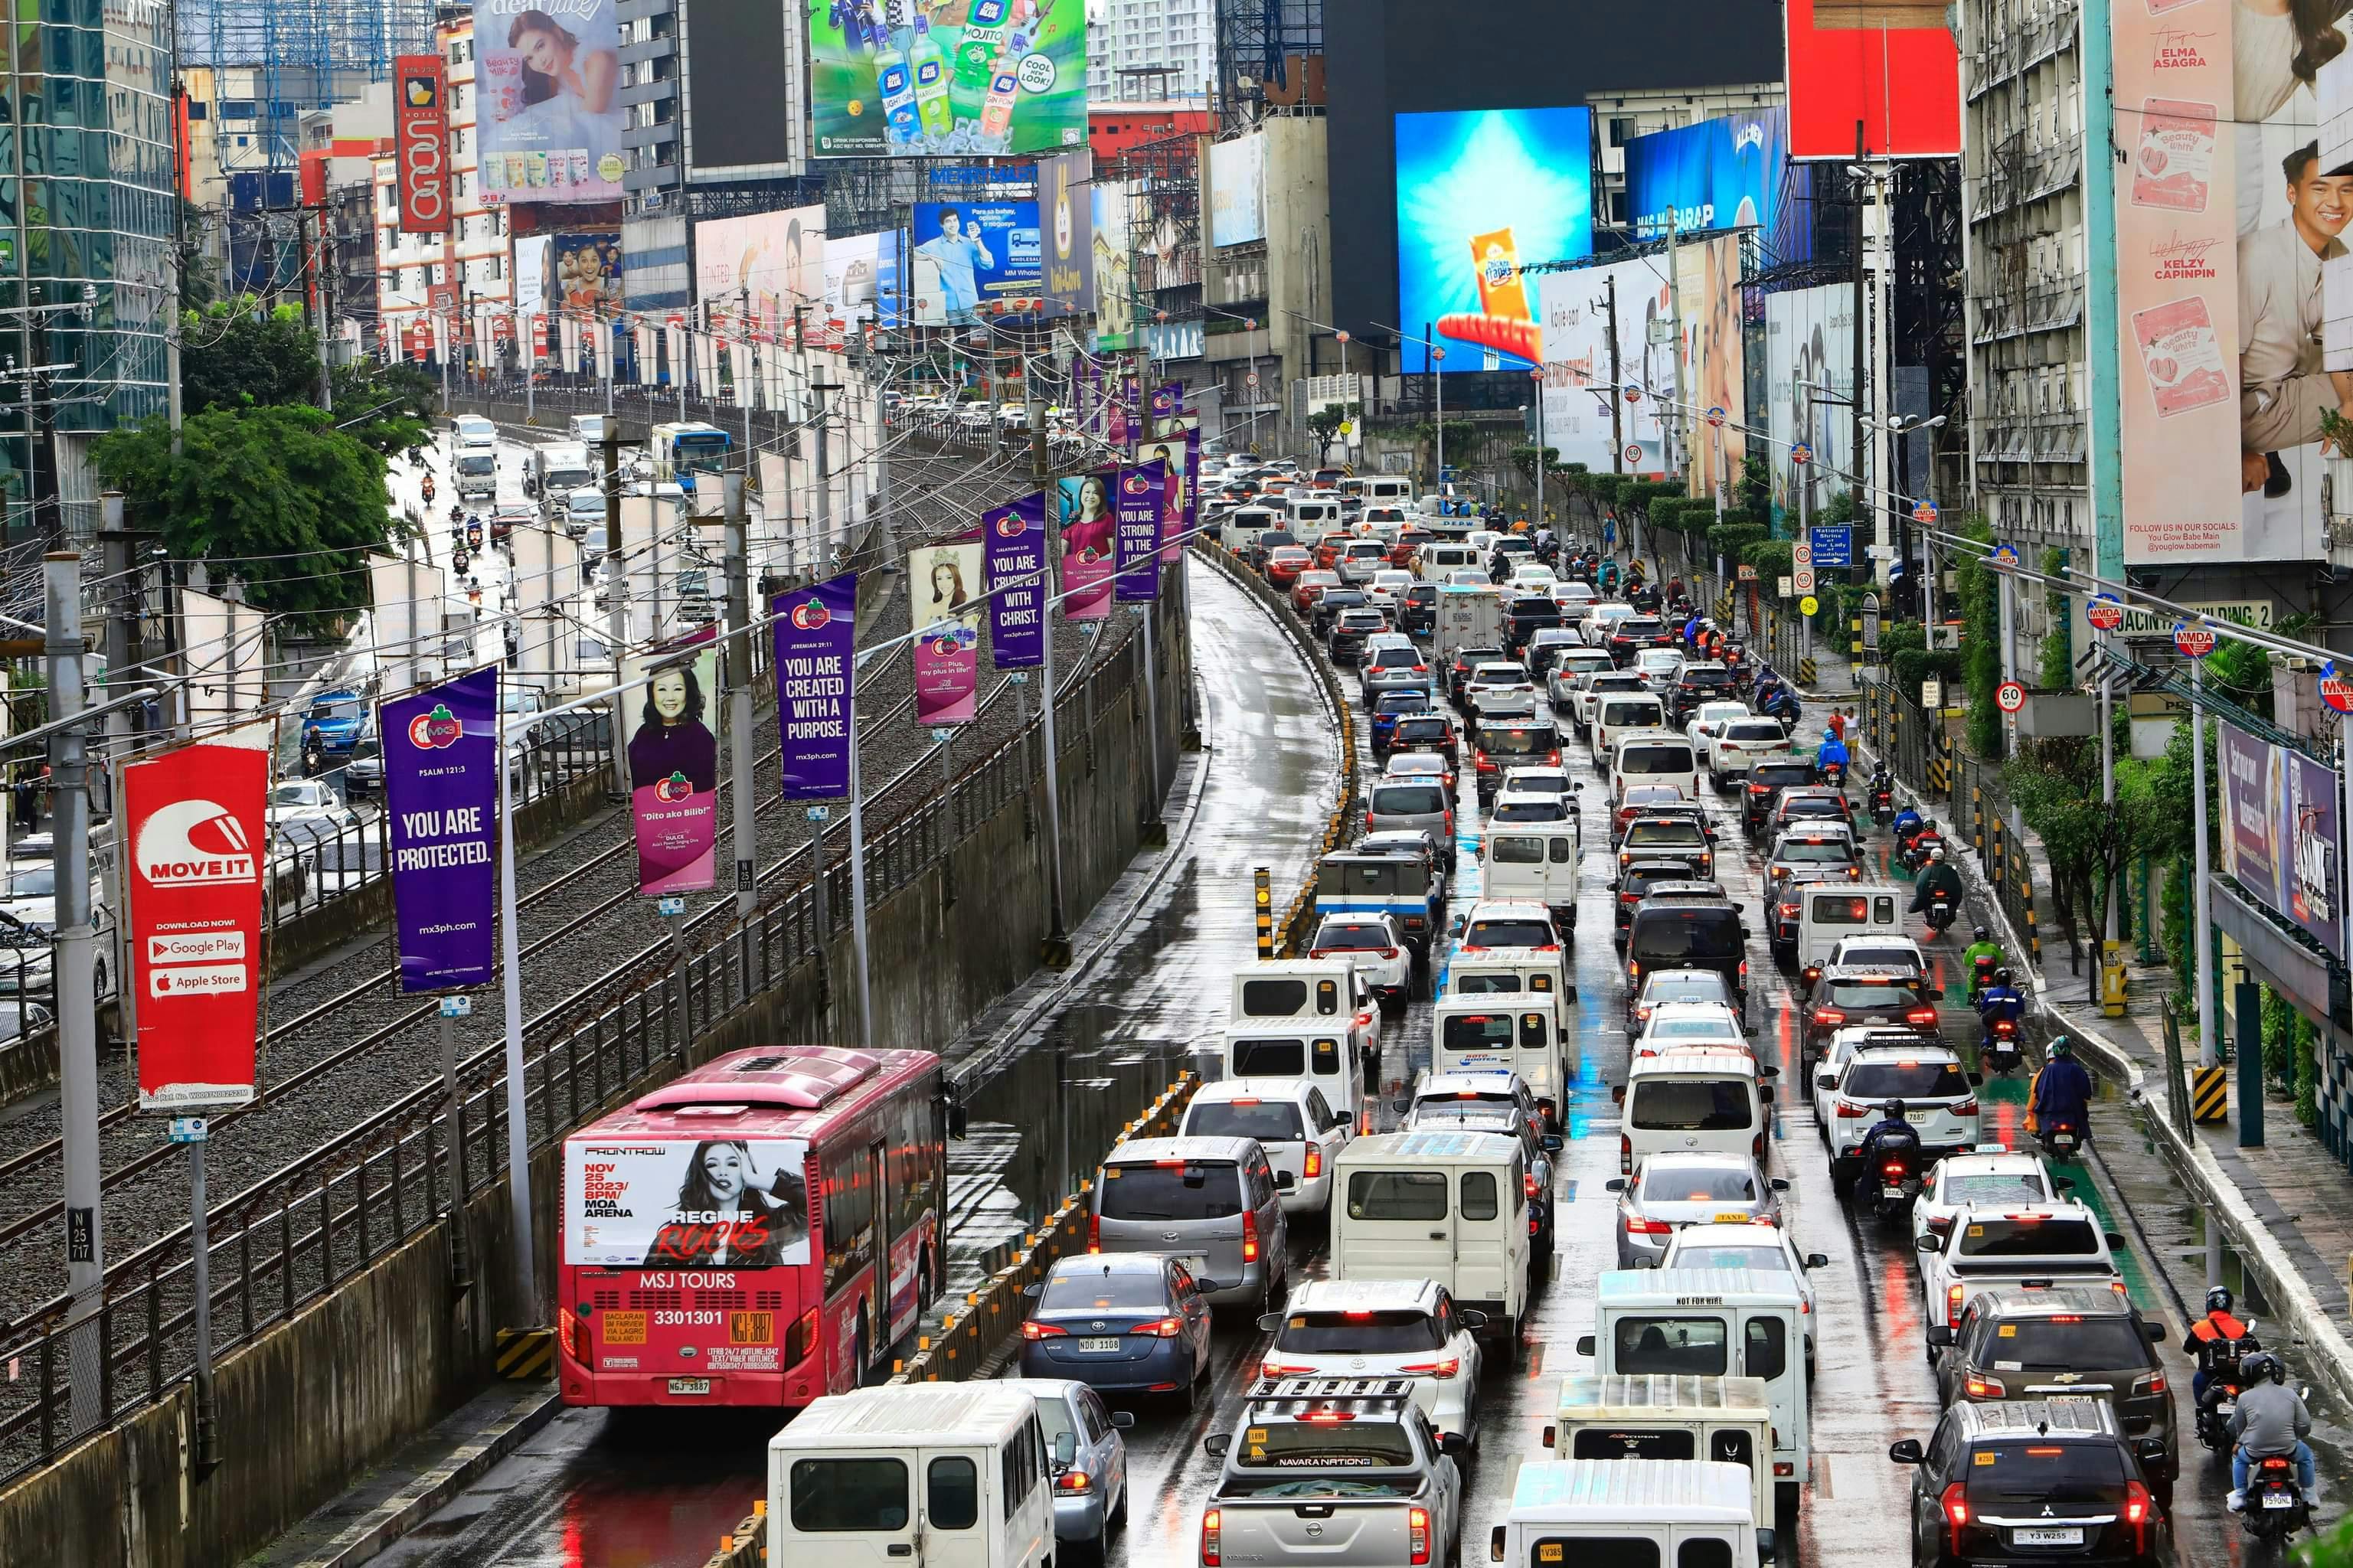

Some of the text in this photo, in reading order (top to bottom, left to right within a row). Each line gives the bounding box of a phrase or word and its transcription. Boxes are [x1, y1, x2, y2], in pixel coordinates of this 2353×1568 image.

[963, 28, 1003, 41] MOJITO
[2162, 48, 2197, 58] ELMA
[1026, 60, 1051, 72] COOL
[2153, 57, 2207, 69] ASAGRA
[1021, 74, 1050, 86] LOOK!
[2162, 132, 2201, 145] Beauty
[2170, 142, 2194, 152] White
[407, 119, 442, 220] SOGO
[1637, 216, 1655, 239] MAS
[2164, 259, 2205, 269] KELZY
[705, 263, 730, 284] TINTED
[2154, 269, 2215, 279] CAPINPIN
[2162, 330, 2198, 351] Beauty
[1119, 510, 1155, 523] YOU ARE
[1120, 524, 1155, 537] STRONG
[2129, 522, 2238, 533] FOLLOW US IN OUR SOCIALS:
[2148, 532, 2220, 542] You Glow Babe Main
[1124, 539, 1152, 551] IN THE
[992, 555, 1037, 573] YOU ARE
[1005, 592, 1031, 607] WITH
[1000, 610, 1039, 626] CHRIST.
[2090, 608, 2120, 619] MMDA
[2260, 606, 2269, 626] 2
[2176, 632, 2214, 643] MMDA
[785, 655, 842, 678] YOU ARE
[786, 676, 845, 698] CREATED
[2002, 689, 2019, 700] 60
[793, 698, 841, 719] WITH A
[428, 724, 456, 737] MX3
[788, 720, 847, 740] PURPOSE.
[796, 752, 837, 760] mx3ph.com
[419, 766, 466, 776] PSALM 121:3
[666, 811, 682, 819] ako
[402, 806, 482, 839] YOU ARE
[397, 841, 492, 871] PROTECTED.
[150, 859, 250, 879] MOVE IT
[740, 872, 750, 880] 25
[156, 921, 210, 930] DOWNLOAD
[419, 922, 476, 935] mx3ph.com
[171, 939, 240, 956] Google Play
[177, 975, 240, 988] Apple Store
[585, 1147, 665, 1155] FRONTROW
[584, 1164, 616, 1172] NOV
[584, 1173, 604, 1181] 25
[584, 1181, 629, 1191] 2023/
[584, 1191, 621, 1200] 8PM/
[584, 1200, 617, 1208] MOA
[584, 1209, 633, 1217] ARENA
[672, 1210, 753, 1223] REGINE
[75, 1214, 83, 1225] N
[73, 1229, 87, 1242] 25
[656, 1215, 770, 1260] ROCKS
[72, 1244, 90, 1258] 717
[639, 1272, 736, 1289] MSJ TOURS
[1676, 1297, 1690, 1305] NOT
[654, 1311, 723, 1325] 3301301
[1080, 1340, 1119, 1350] NDO 1108
[669, 1382, 708, 1391] NGJ 3887
